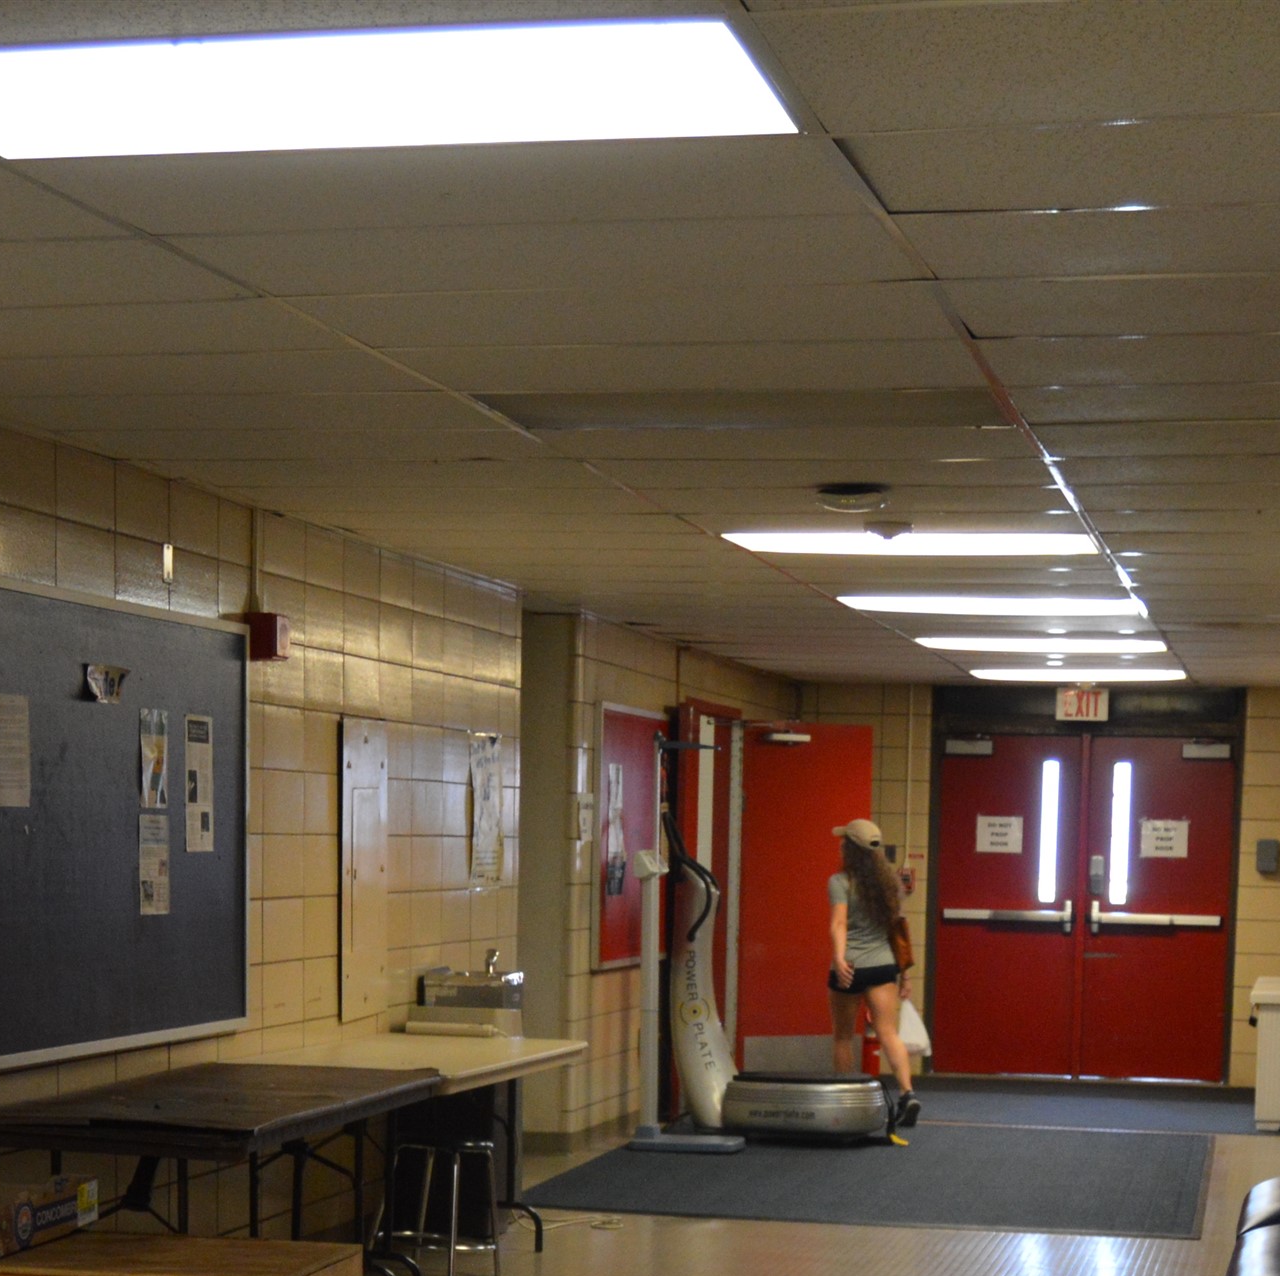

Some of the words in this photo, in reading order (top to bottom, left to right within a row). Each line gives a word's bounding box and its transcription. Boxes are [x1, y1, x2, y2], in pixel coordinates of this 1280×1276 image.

[1063, 690, 1102, 718] EXIT
[684, 949, 699, 1001] POWER
[693, 1022, 717, 1071] PLATE
